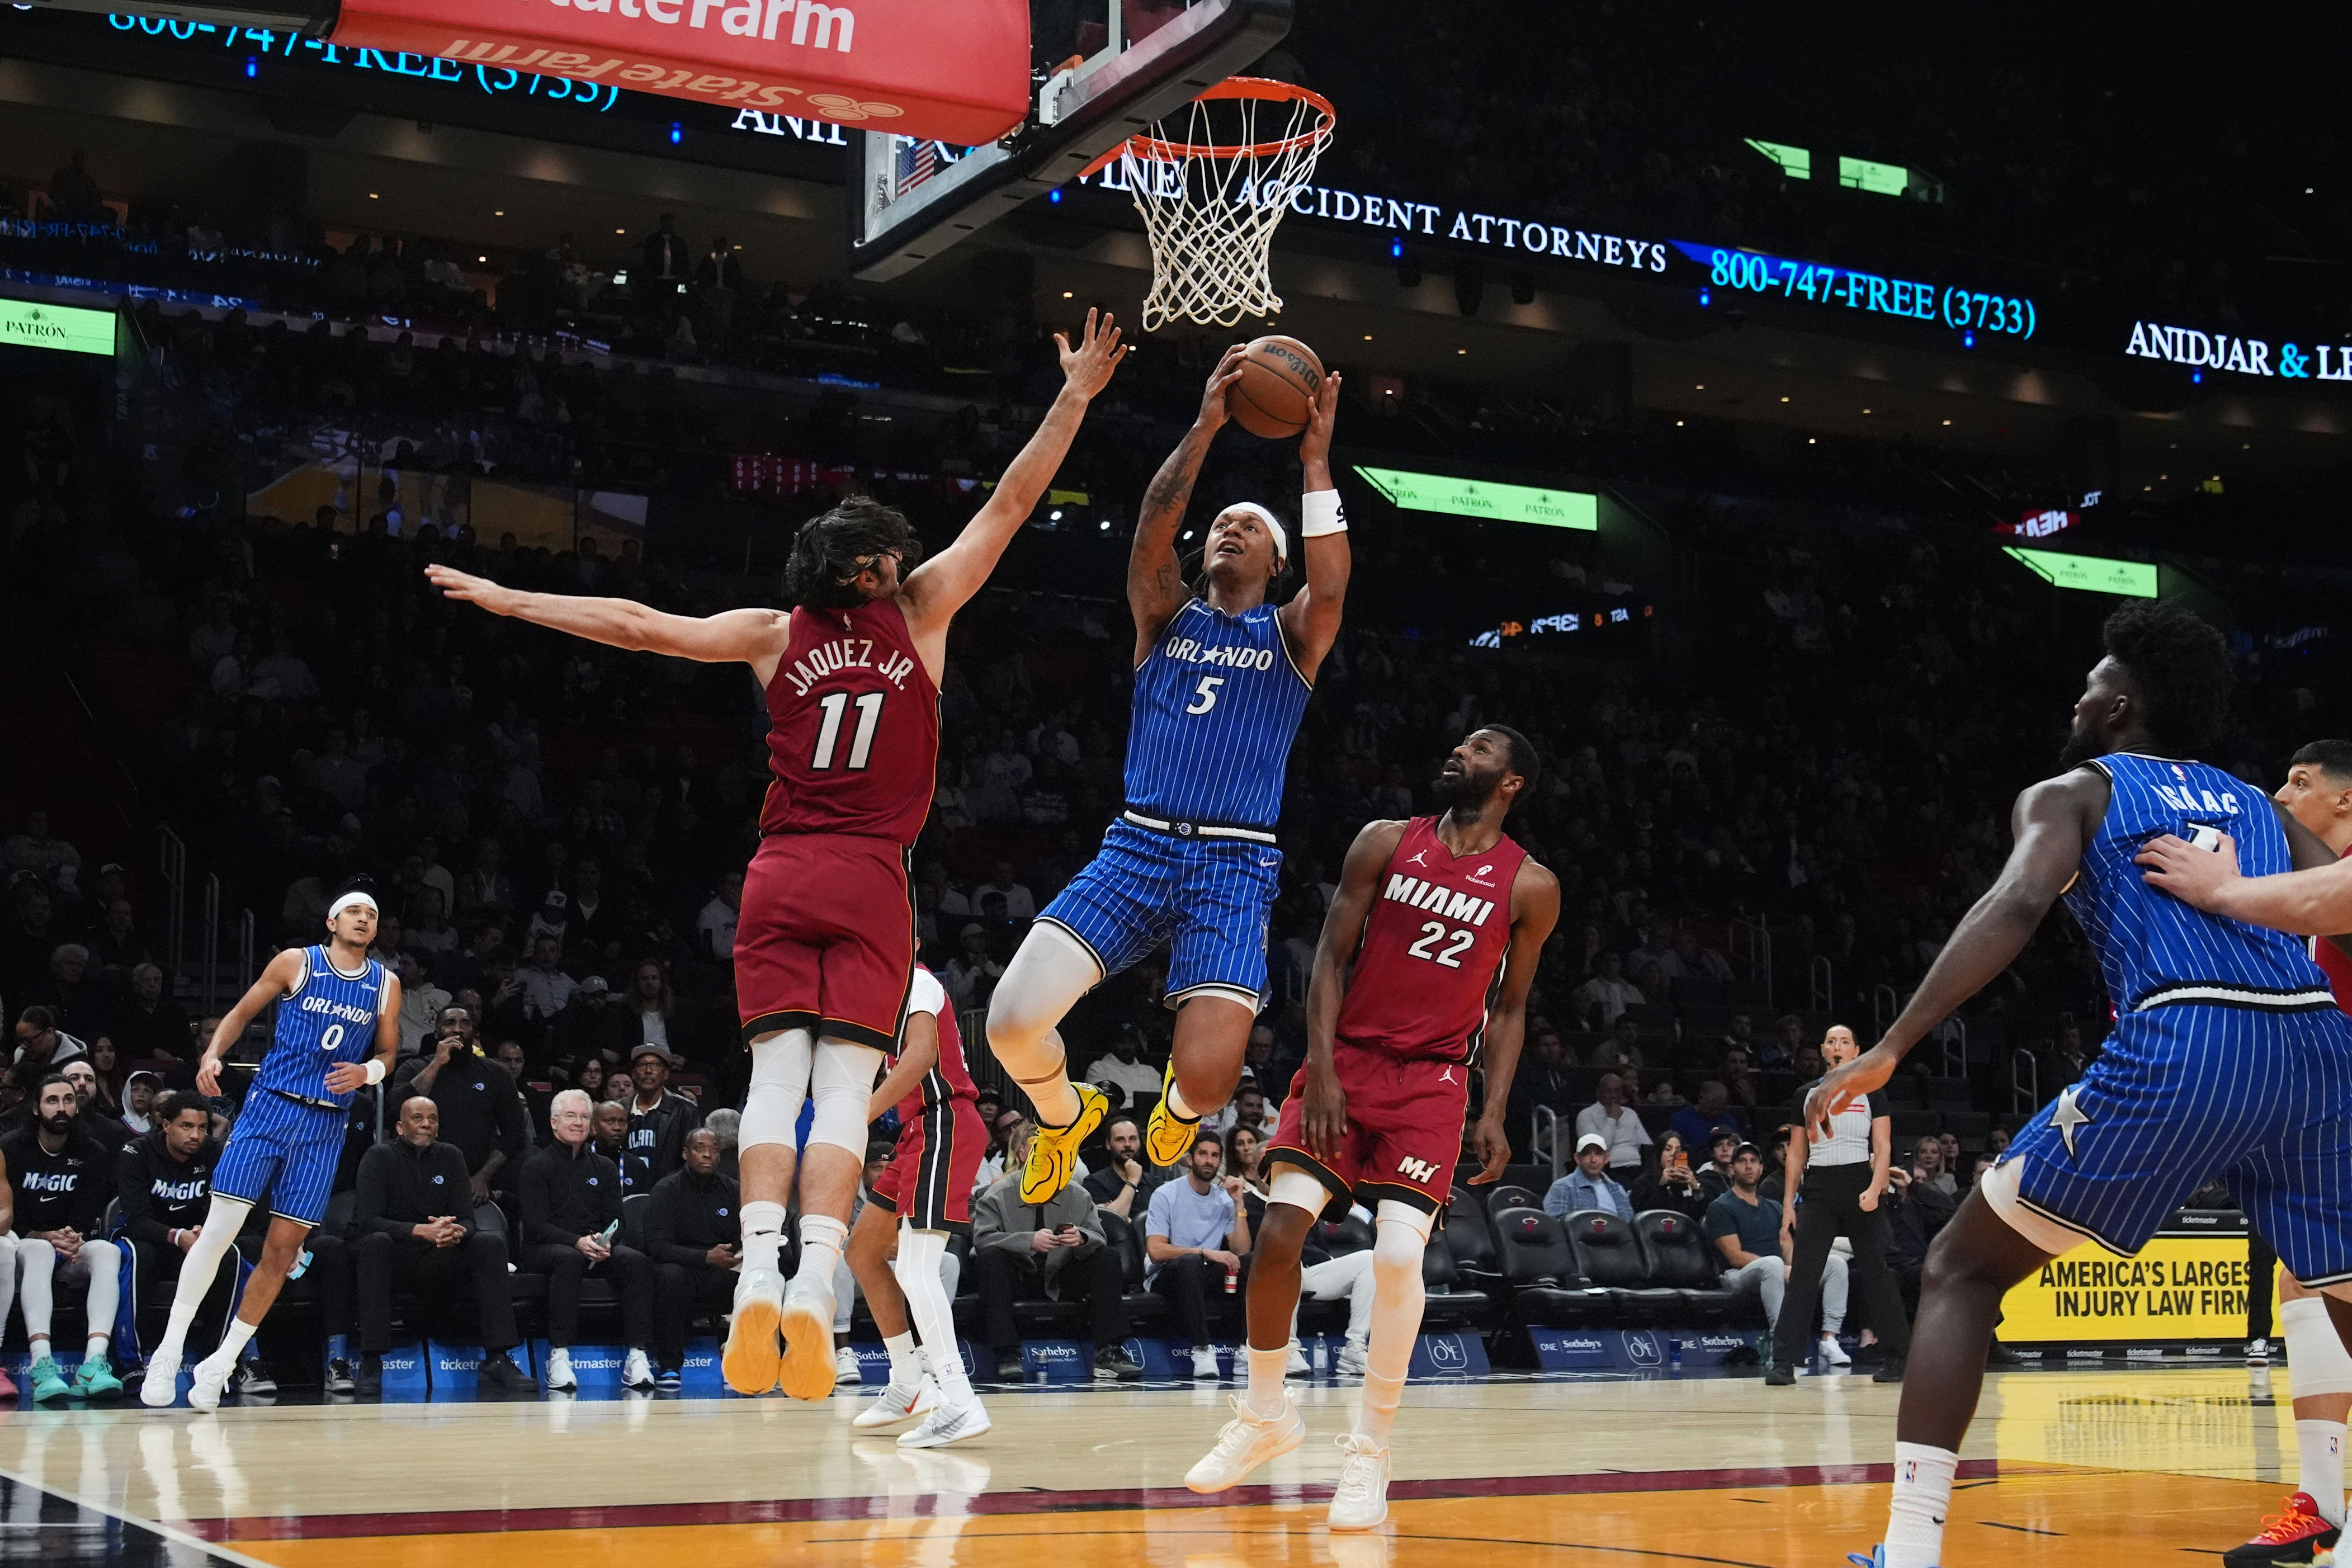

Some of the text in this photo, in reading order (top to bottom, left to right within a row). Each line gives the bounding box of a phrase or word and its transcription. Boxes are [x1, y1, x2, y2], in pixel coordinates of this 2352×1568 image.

[439, 40, 804, 106] StateFarm
[1235, 176, 1440, 235] ACCIDENT
[1449, 211, 1667, 273] ATTORNEYS
[1711, 249, 2036, 340] 800-747-FREE (3733)
[2126, 320, 2274, 376] ANIDJAR
[2279, 343, 2310, 378] &
[785, 639, 914, 697] JAQUEZ JR.
[1186, 676, 1225, 715] 5
[811, 692, 886, 770] 11
[2149, 784, 2238, 815] ISAAC
[1383, 872, 1496, 927] MIAMI
[1465, 875, 1496, 888] Robinhood
[1407, 920, 1476, 969] 22
[320, 1024, 344, 1051] 0
[2182, 1216, 2218, 1225] ticketmaster
[2056, 1290, 2140, 1317] INJURY
[2147, 1290, 2193, 1316] LAW
[1172, 1348, 1192, 1357] ONE
[1540, 1343, 1558, 1351] ONE
[2127, 1348, 2163, 1357] ticketmaster
[2185, 1347, 2222, 1356] ticketmaster
